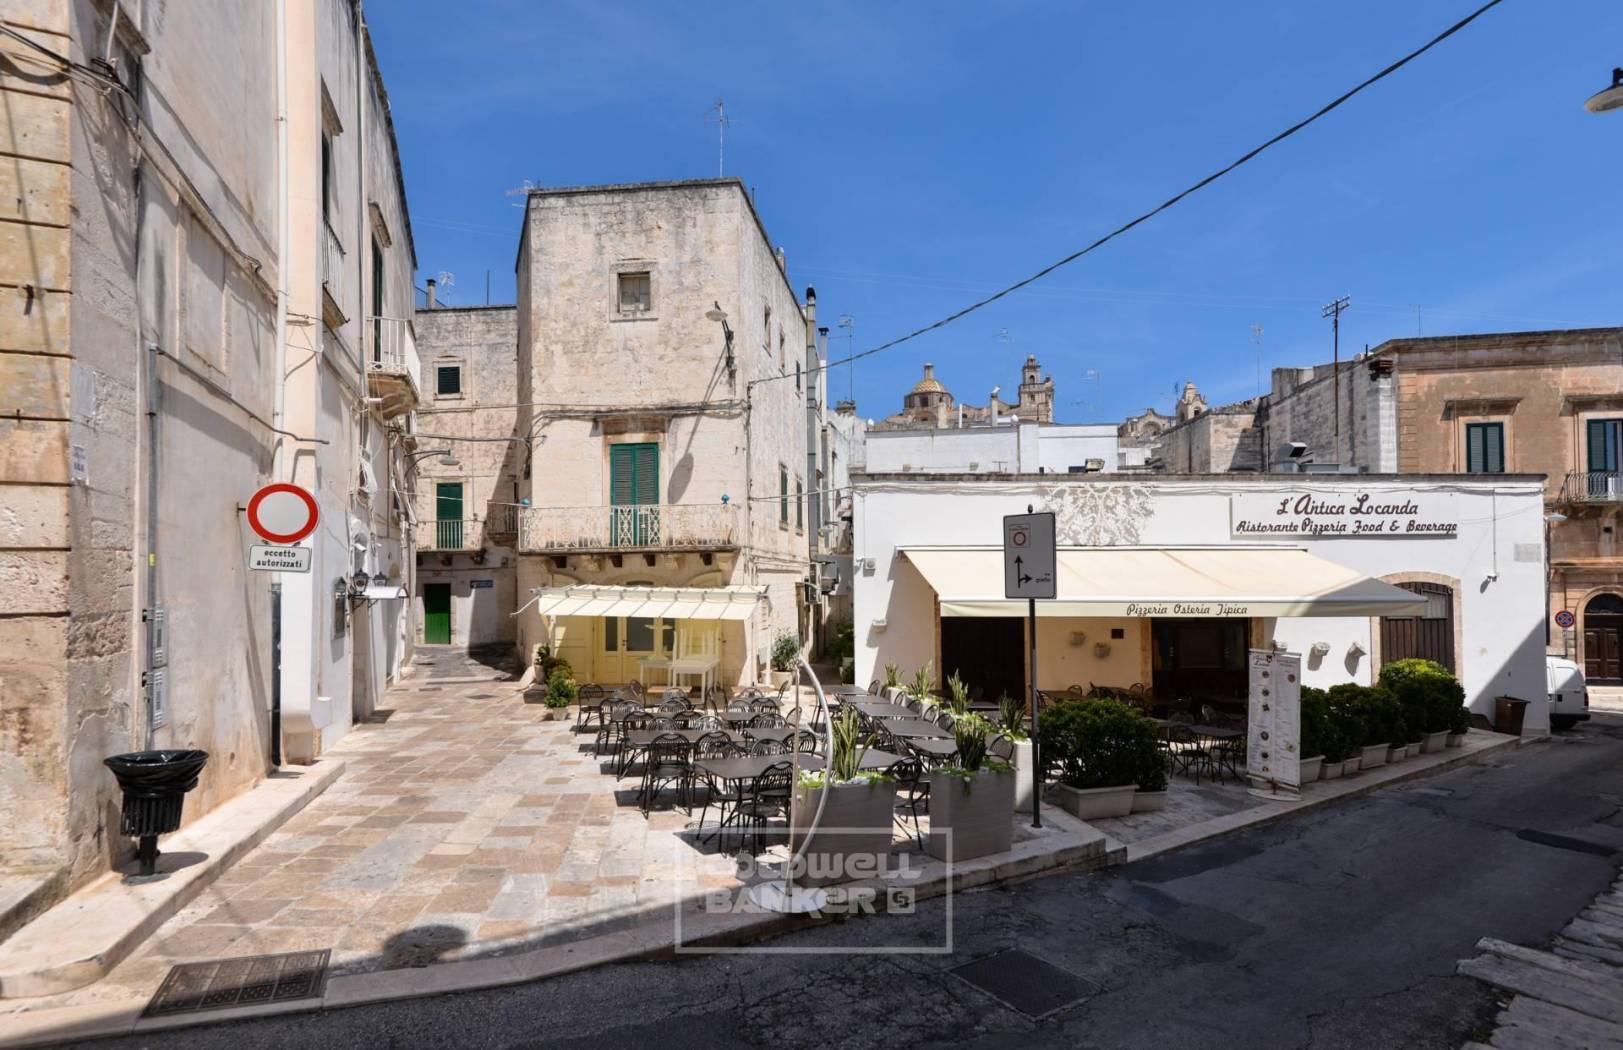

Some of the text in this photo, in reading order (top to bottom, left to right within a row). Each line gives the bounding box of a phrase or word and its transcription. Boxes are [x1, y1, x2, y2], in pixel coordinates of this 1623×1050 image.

[1350, 494, 1419, 515] Locanda
[1236, 518, 1458, 534] Ristorante Pizzeria Food & Beverage
[264, 550, 296, 558] eccetto
[256, 559, 302, 568] autorizzati
[1126, 603, 1248, 617] Pizzeria Osteria Tipica
